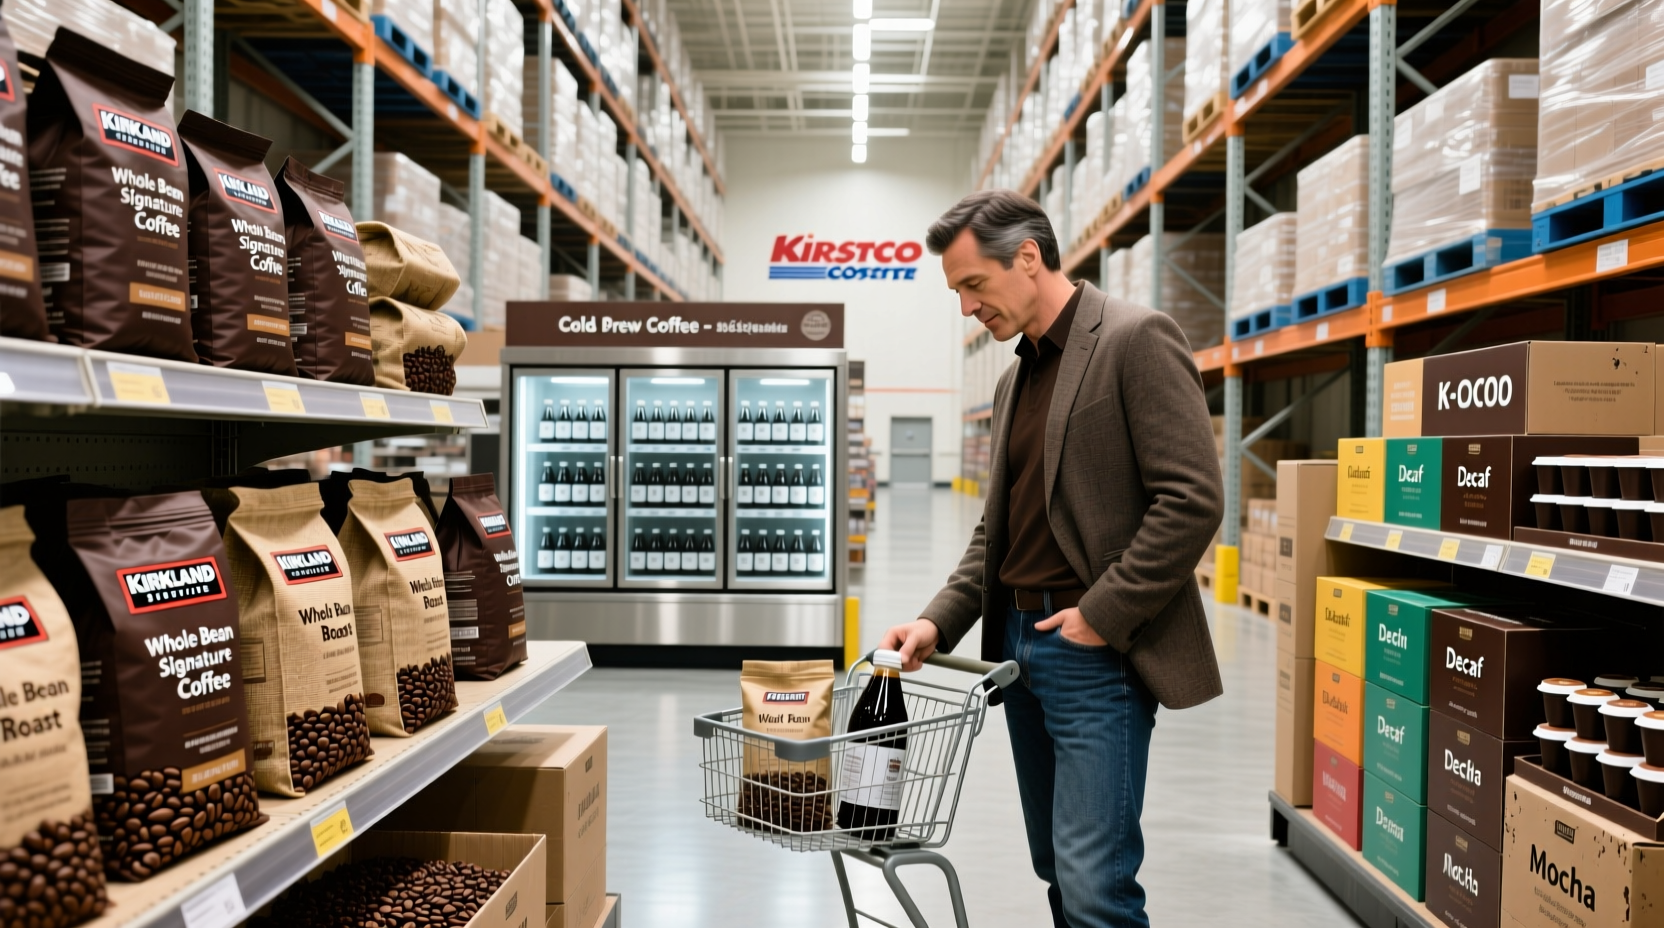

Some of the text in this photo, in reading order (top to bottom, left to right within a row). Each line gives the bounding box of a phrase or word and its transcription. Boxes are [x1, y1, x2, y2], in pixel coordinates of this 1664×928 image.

[112, 166, 156, 192] Whole
[134, 211, 181, 238] Coffee
[558, 315, 597, 333] Cold
[601, 316, 643, 334] Brew
[646, 316, 700, 334] Coffee
[1457, 465, 1492, 488] Decaf
[125, 564, 216, 595] KIRKLAND
[144, 625, 235, 658] Whole Bean
[158, 647, 233, 679] Signature
[1445, 646, 1485, 678] Decaf
[22, 679, 70, 703] Bean
[176, 669, 232, 700] Coffee
[0, 709, 63, 743] Roast
[1529, 843, 1596, 913] Mocha
